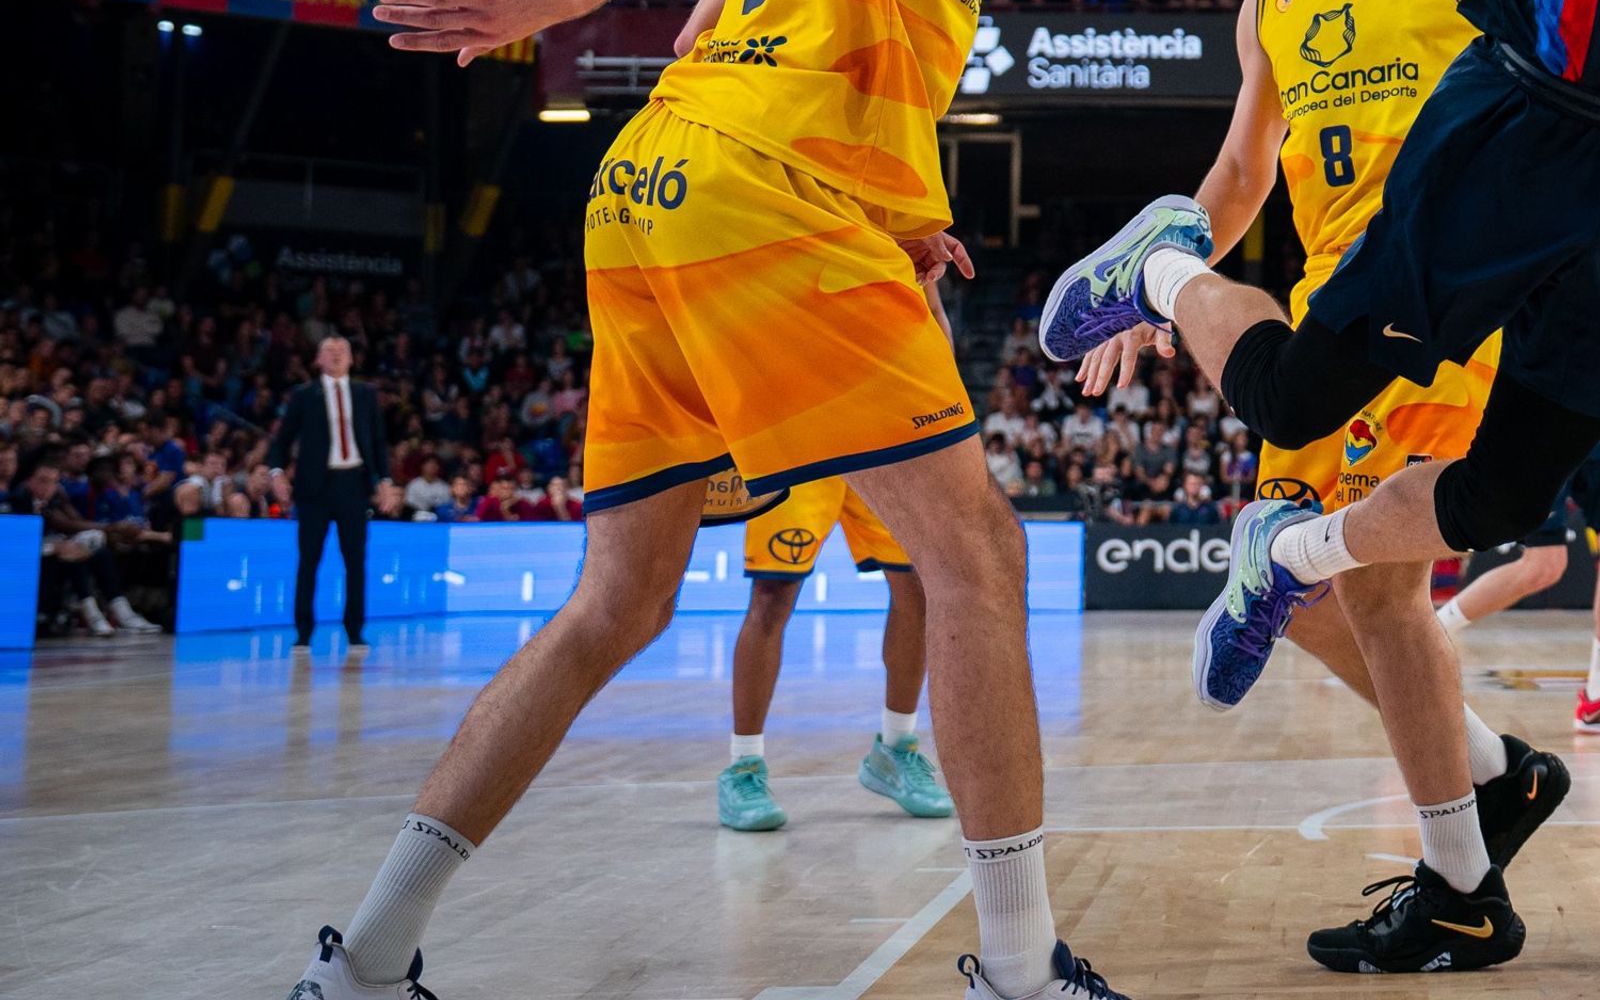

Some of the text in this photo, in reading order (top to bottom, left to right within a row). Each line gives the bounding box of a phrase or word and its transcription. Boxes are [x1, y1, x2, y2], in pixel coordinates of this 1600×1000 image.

[1026, 26, 1203, 60] Assistència
[1026, 56, 1150, 90] Sanitària
[1333, 92, 1356, 107] del
[1360, 85, 1418, 103] Deporte
[1319, 124, 1356, 188] 8
[911, 401, 965, 430] SPALDING
[1096, 528, 1230, 574] ende
